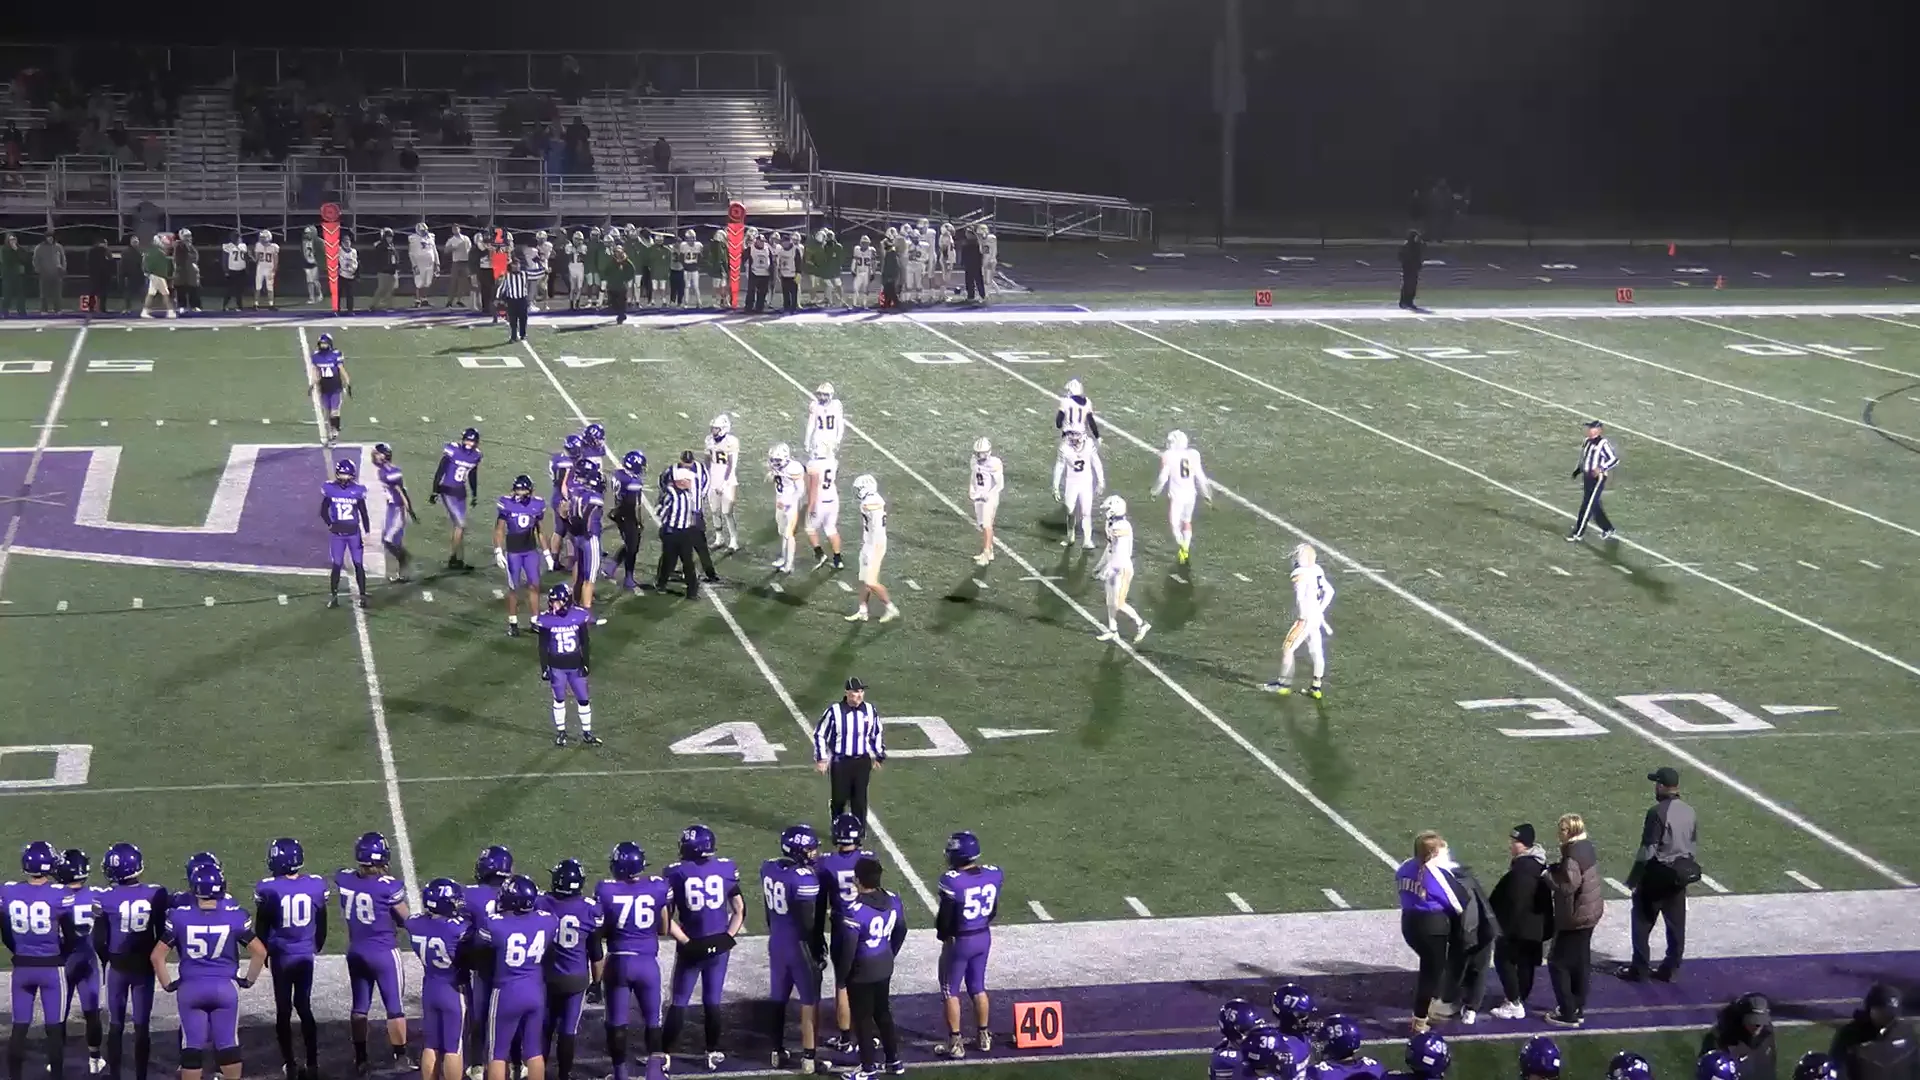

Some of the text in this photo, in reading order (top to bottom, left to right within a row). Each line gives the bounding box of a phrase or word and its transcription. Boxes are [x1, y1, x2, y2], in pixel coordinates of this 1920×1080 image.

[1259, 291, 1271, 304] 20
[817, 415, 835, 430] 10
[1069, 407, 1082, 425] 11
[822, 469, 832, 490] 5
[1073, 460, 1085, 472] 3
[336, 503, 354, 521] 12
[555, 631, 576, 653] 15
[339, 887, 376, 925] 78
[685, 875, 724, 911] 69
[763, 876, 789, 914] 68
[963, 883, 997, 920] 53
[8, 899, 52, 935] 88
[119, 899, 152, 933] 16
[280, 893, 312, 928] 10
[612, 894, 656, 930] 76
[185, 925, 231, 959] 57
[866, 909, 897, 948] 94
[411, 935, 452, 969] 73
[505, 930, 547, 967] 64
[1020, 1006, 1059, 1041] 40
